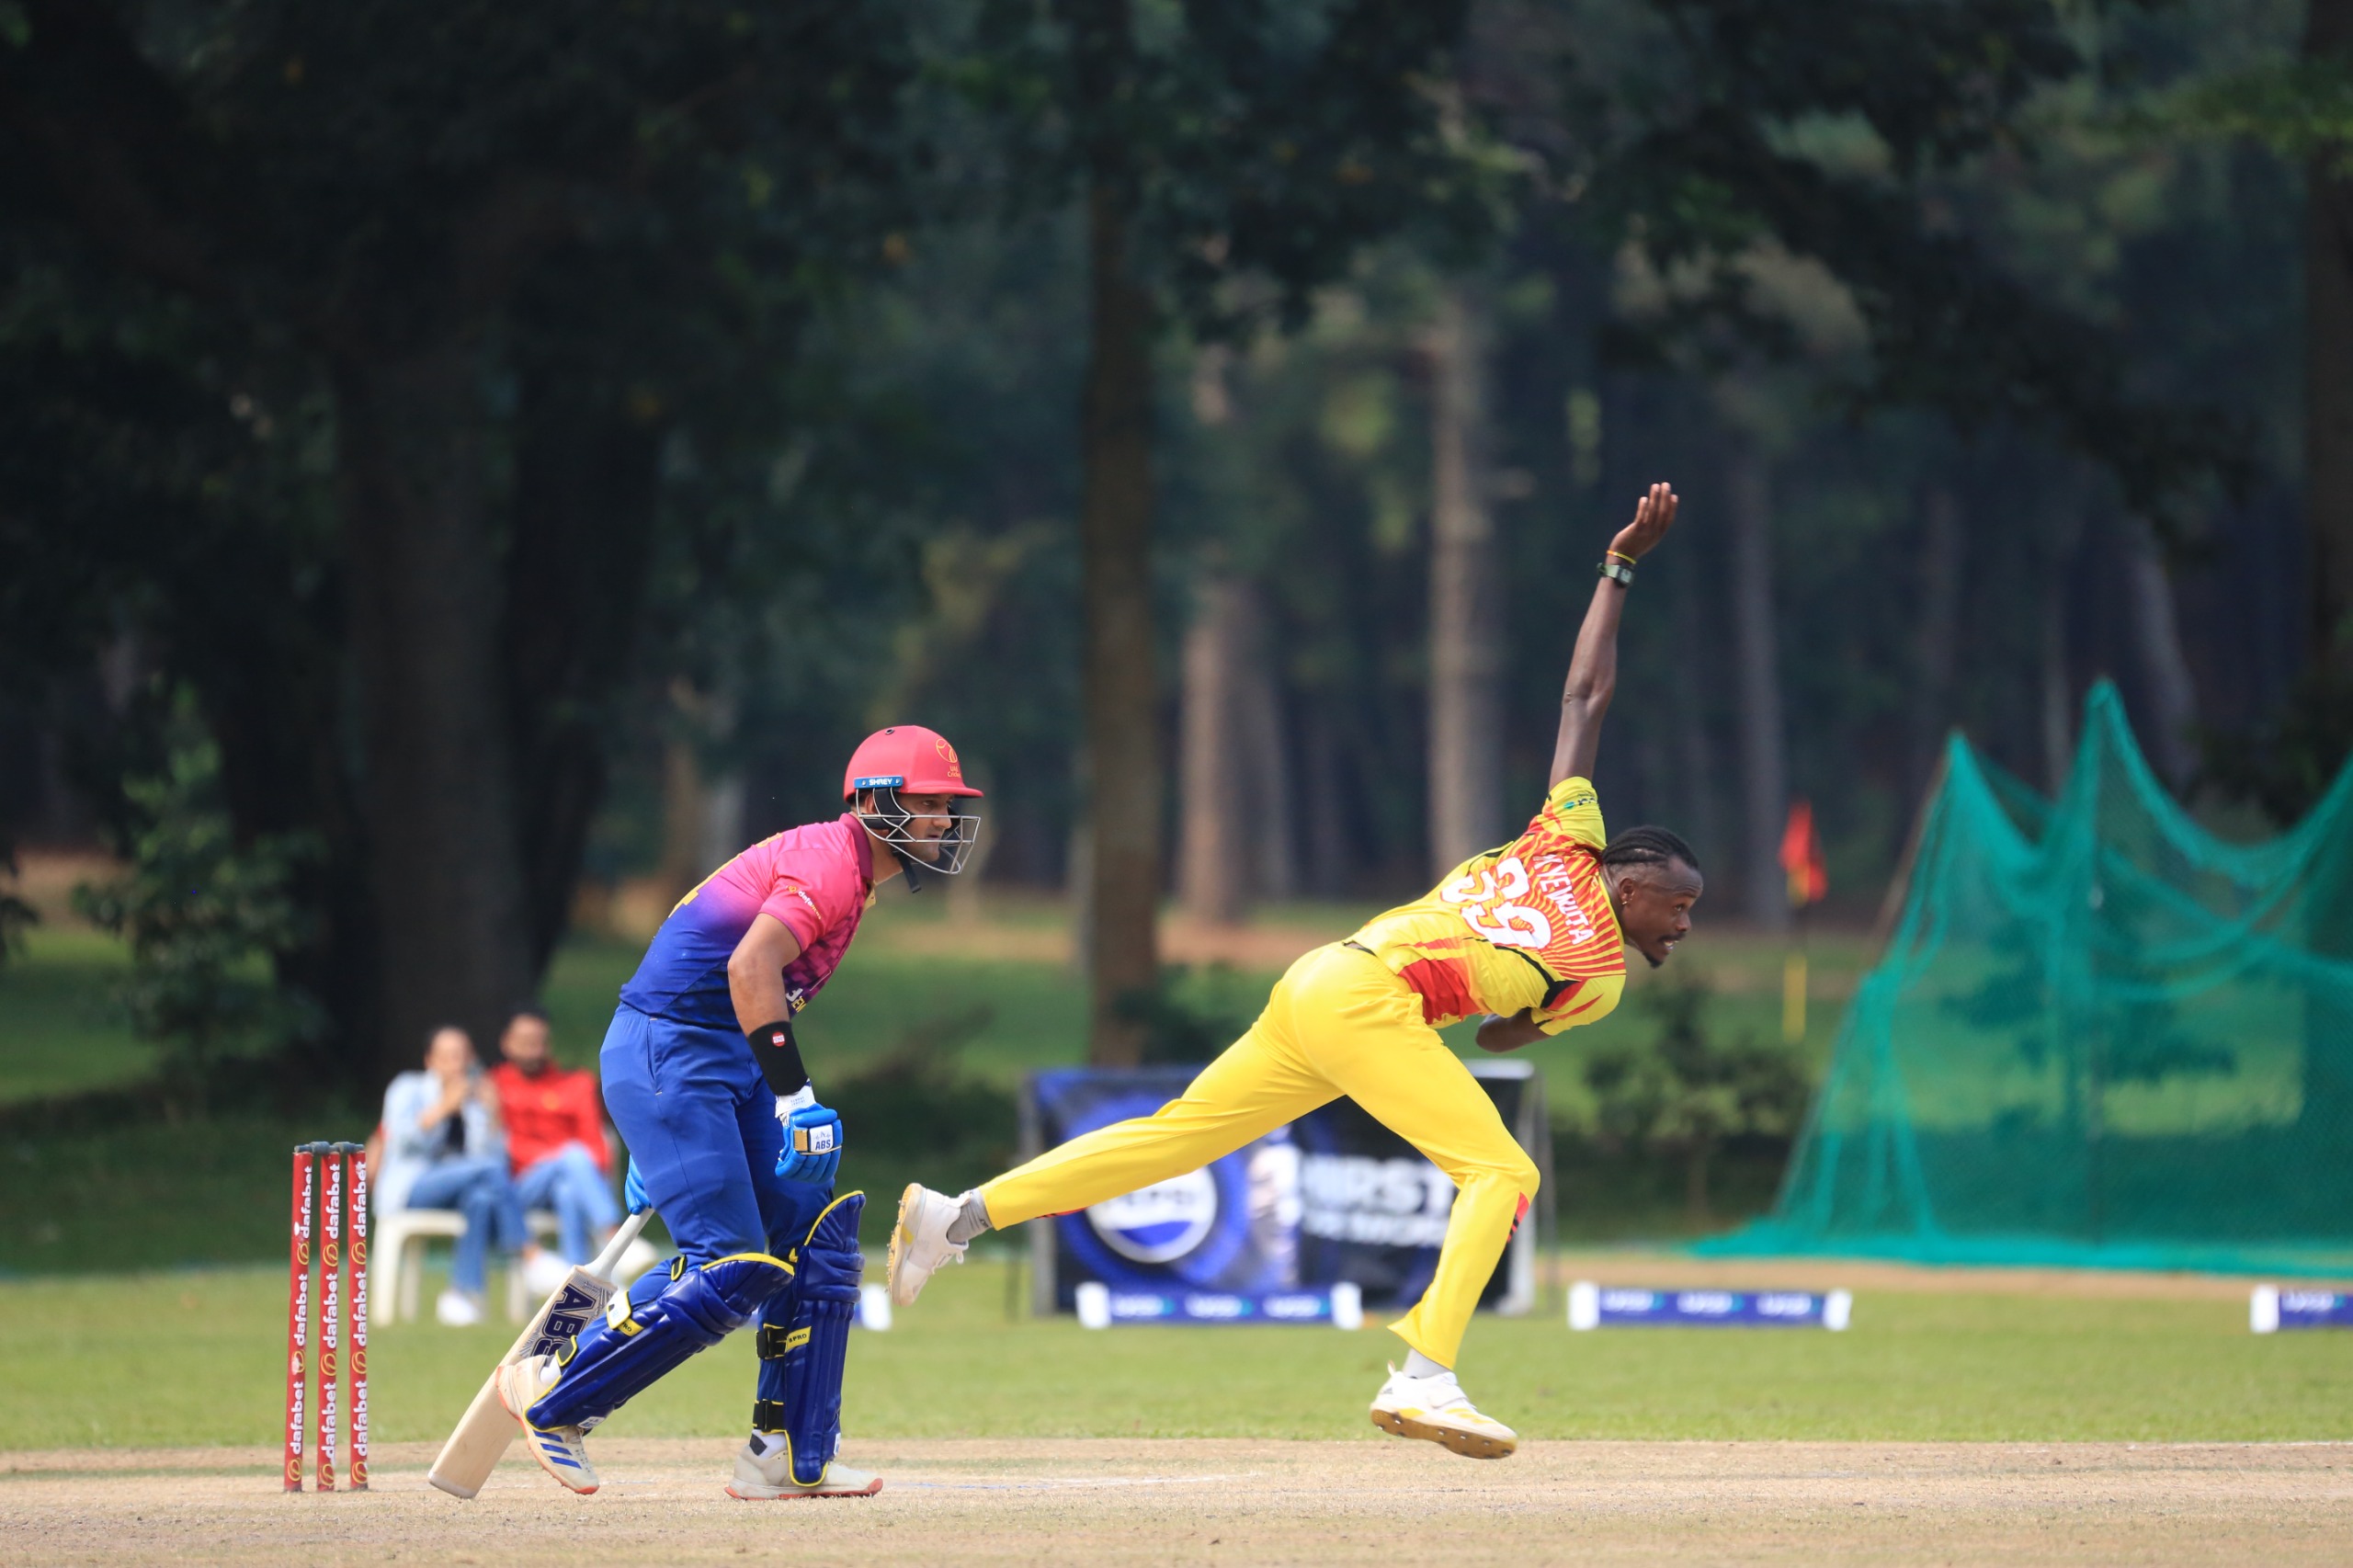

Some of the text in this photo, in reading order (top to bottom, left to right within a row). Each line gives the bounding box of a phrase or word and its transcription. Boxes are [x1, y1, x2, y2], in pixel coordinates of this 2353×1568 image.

[869, 778, 892, 786] SHREY
[1442, 857, 1552, 949] 39
[1532, 854, 1595, 945] KYEWUTA
[815, 1139, 831, 1151] ABS
[300, 1165, 313, 1239] dafabet
[325, 1164, 341, 1240] dafabet
[353, 1161, 367, 1238] dafabet
[293, 1273, 308, 1346] dafabet
[323, 1273, 338, 1349] dafabet
[353, 1271, 367, 1346] dafabet
[793, 1333, 807, 1342] PRO
[290, 1381, 304, 1455] dafabet
[321, 1382, 336, 1460] dafabet
[353, 1381, 368, 1457] dafabet
